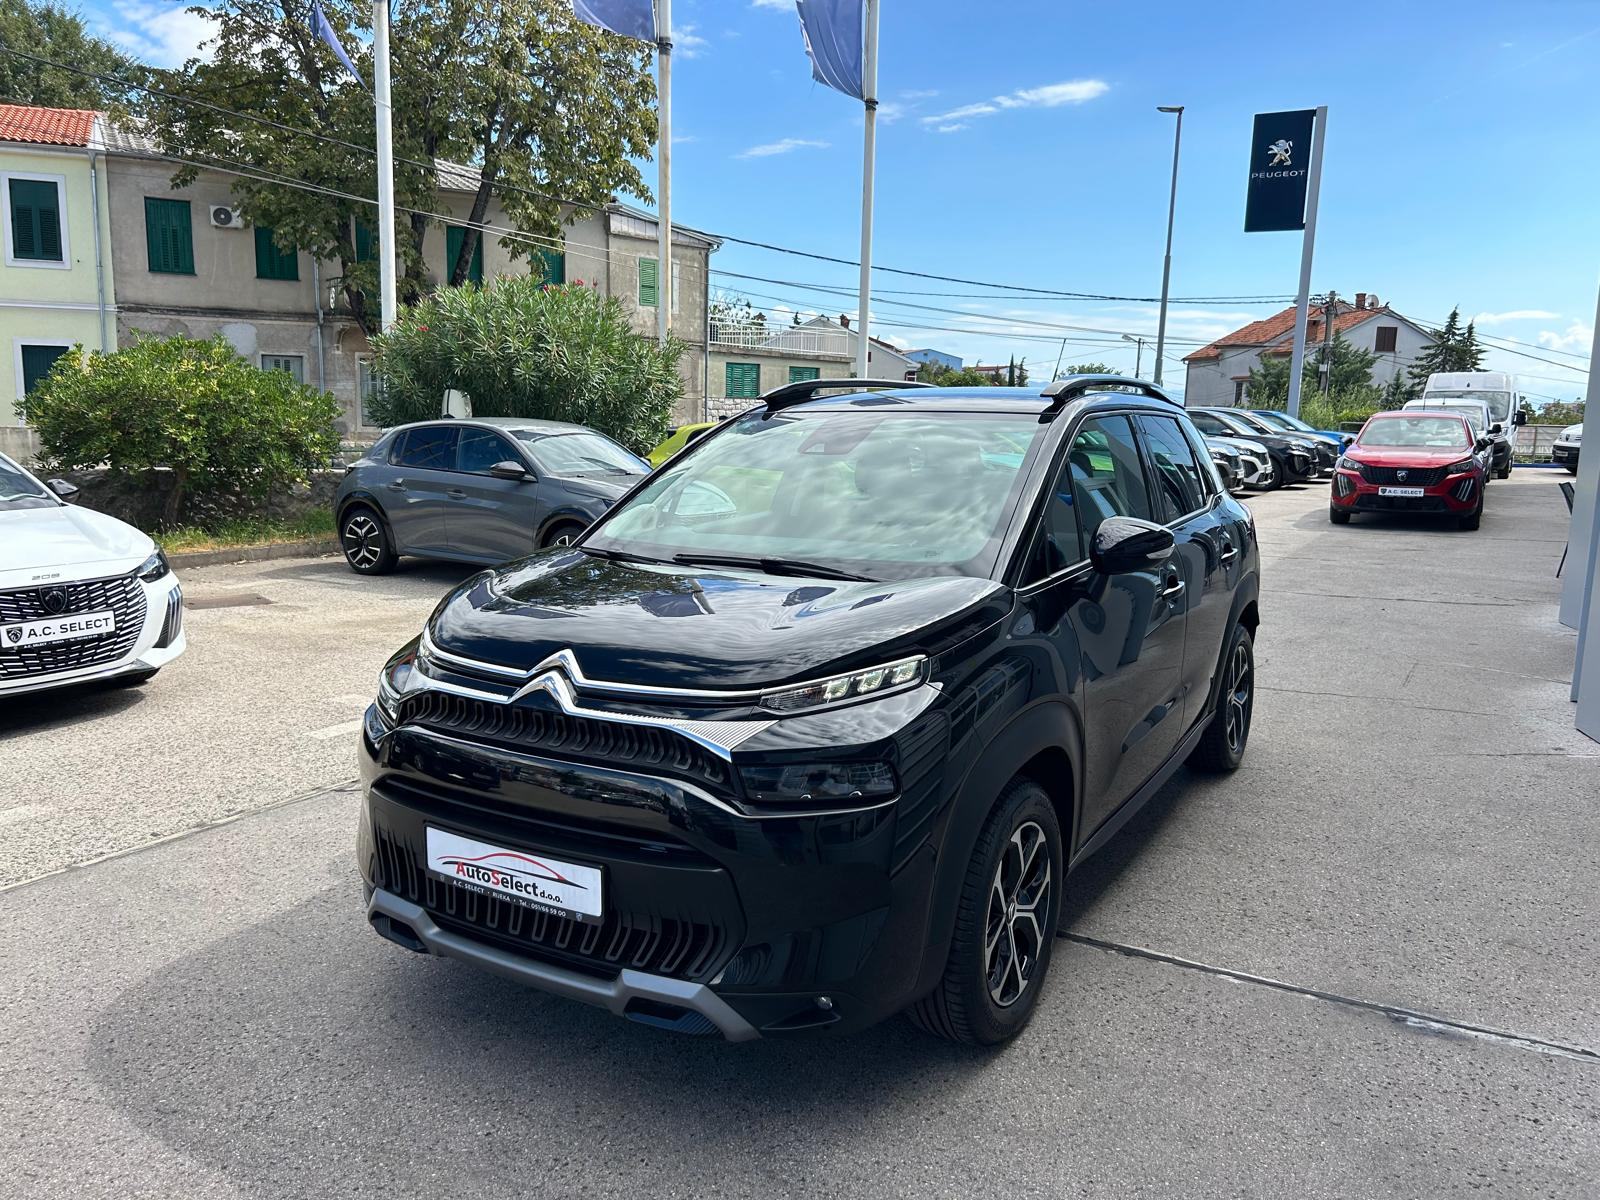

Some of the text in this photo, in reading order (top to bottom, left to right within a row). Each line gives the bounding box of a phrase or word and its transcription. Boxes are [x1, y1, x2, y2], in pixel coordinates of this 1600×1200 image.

[1251, 170, 1305, 179] PEUGEOT
[27, 626, 56, 638] A.C.
[59, 617, 111, 634] SELECT
[455, 861, 563, 904] AutoSelect d.o.o.
[464, 883, 485, 893] SELECT
[492, 891, 511, 901] RIJEKA
